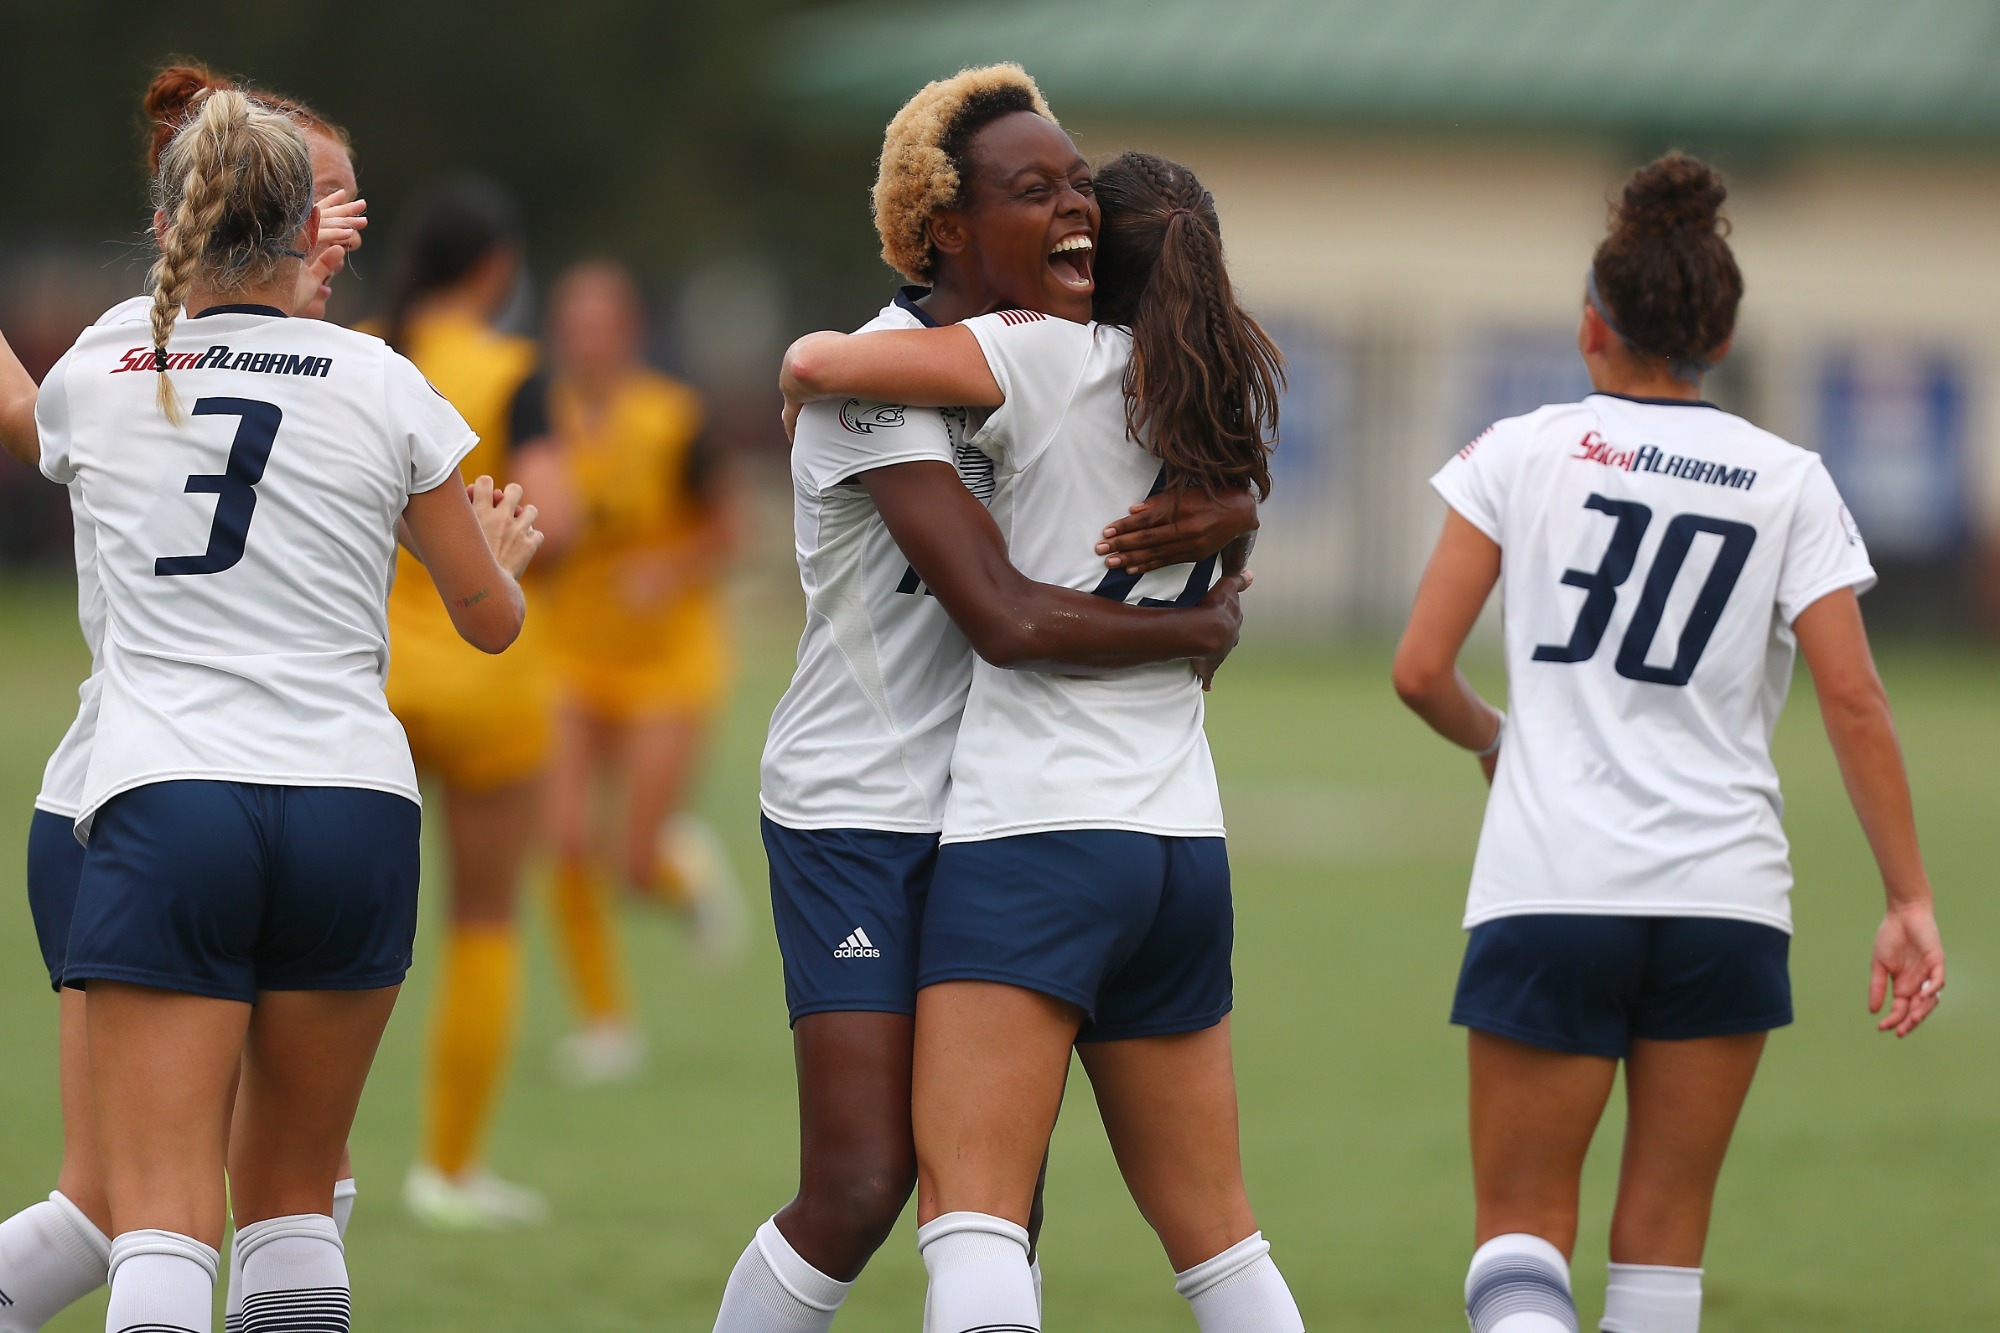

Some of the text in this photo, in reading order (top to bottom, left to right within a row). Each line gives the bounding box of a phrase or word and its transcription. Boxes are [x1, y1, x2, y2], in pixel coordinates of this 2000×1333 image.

[154, 396, 283, 577] 3
[1532, 493, 1757, 688] 30
[833, 946, 881, 959] adidas
